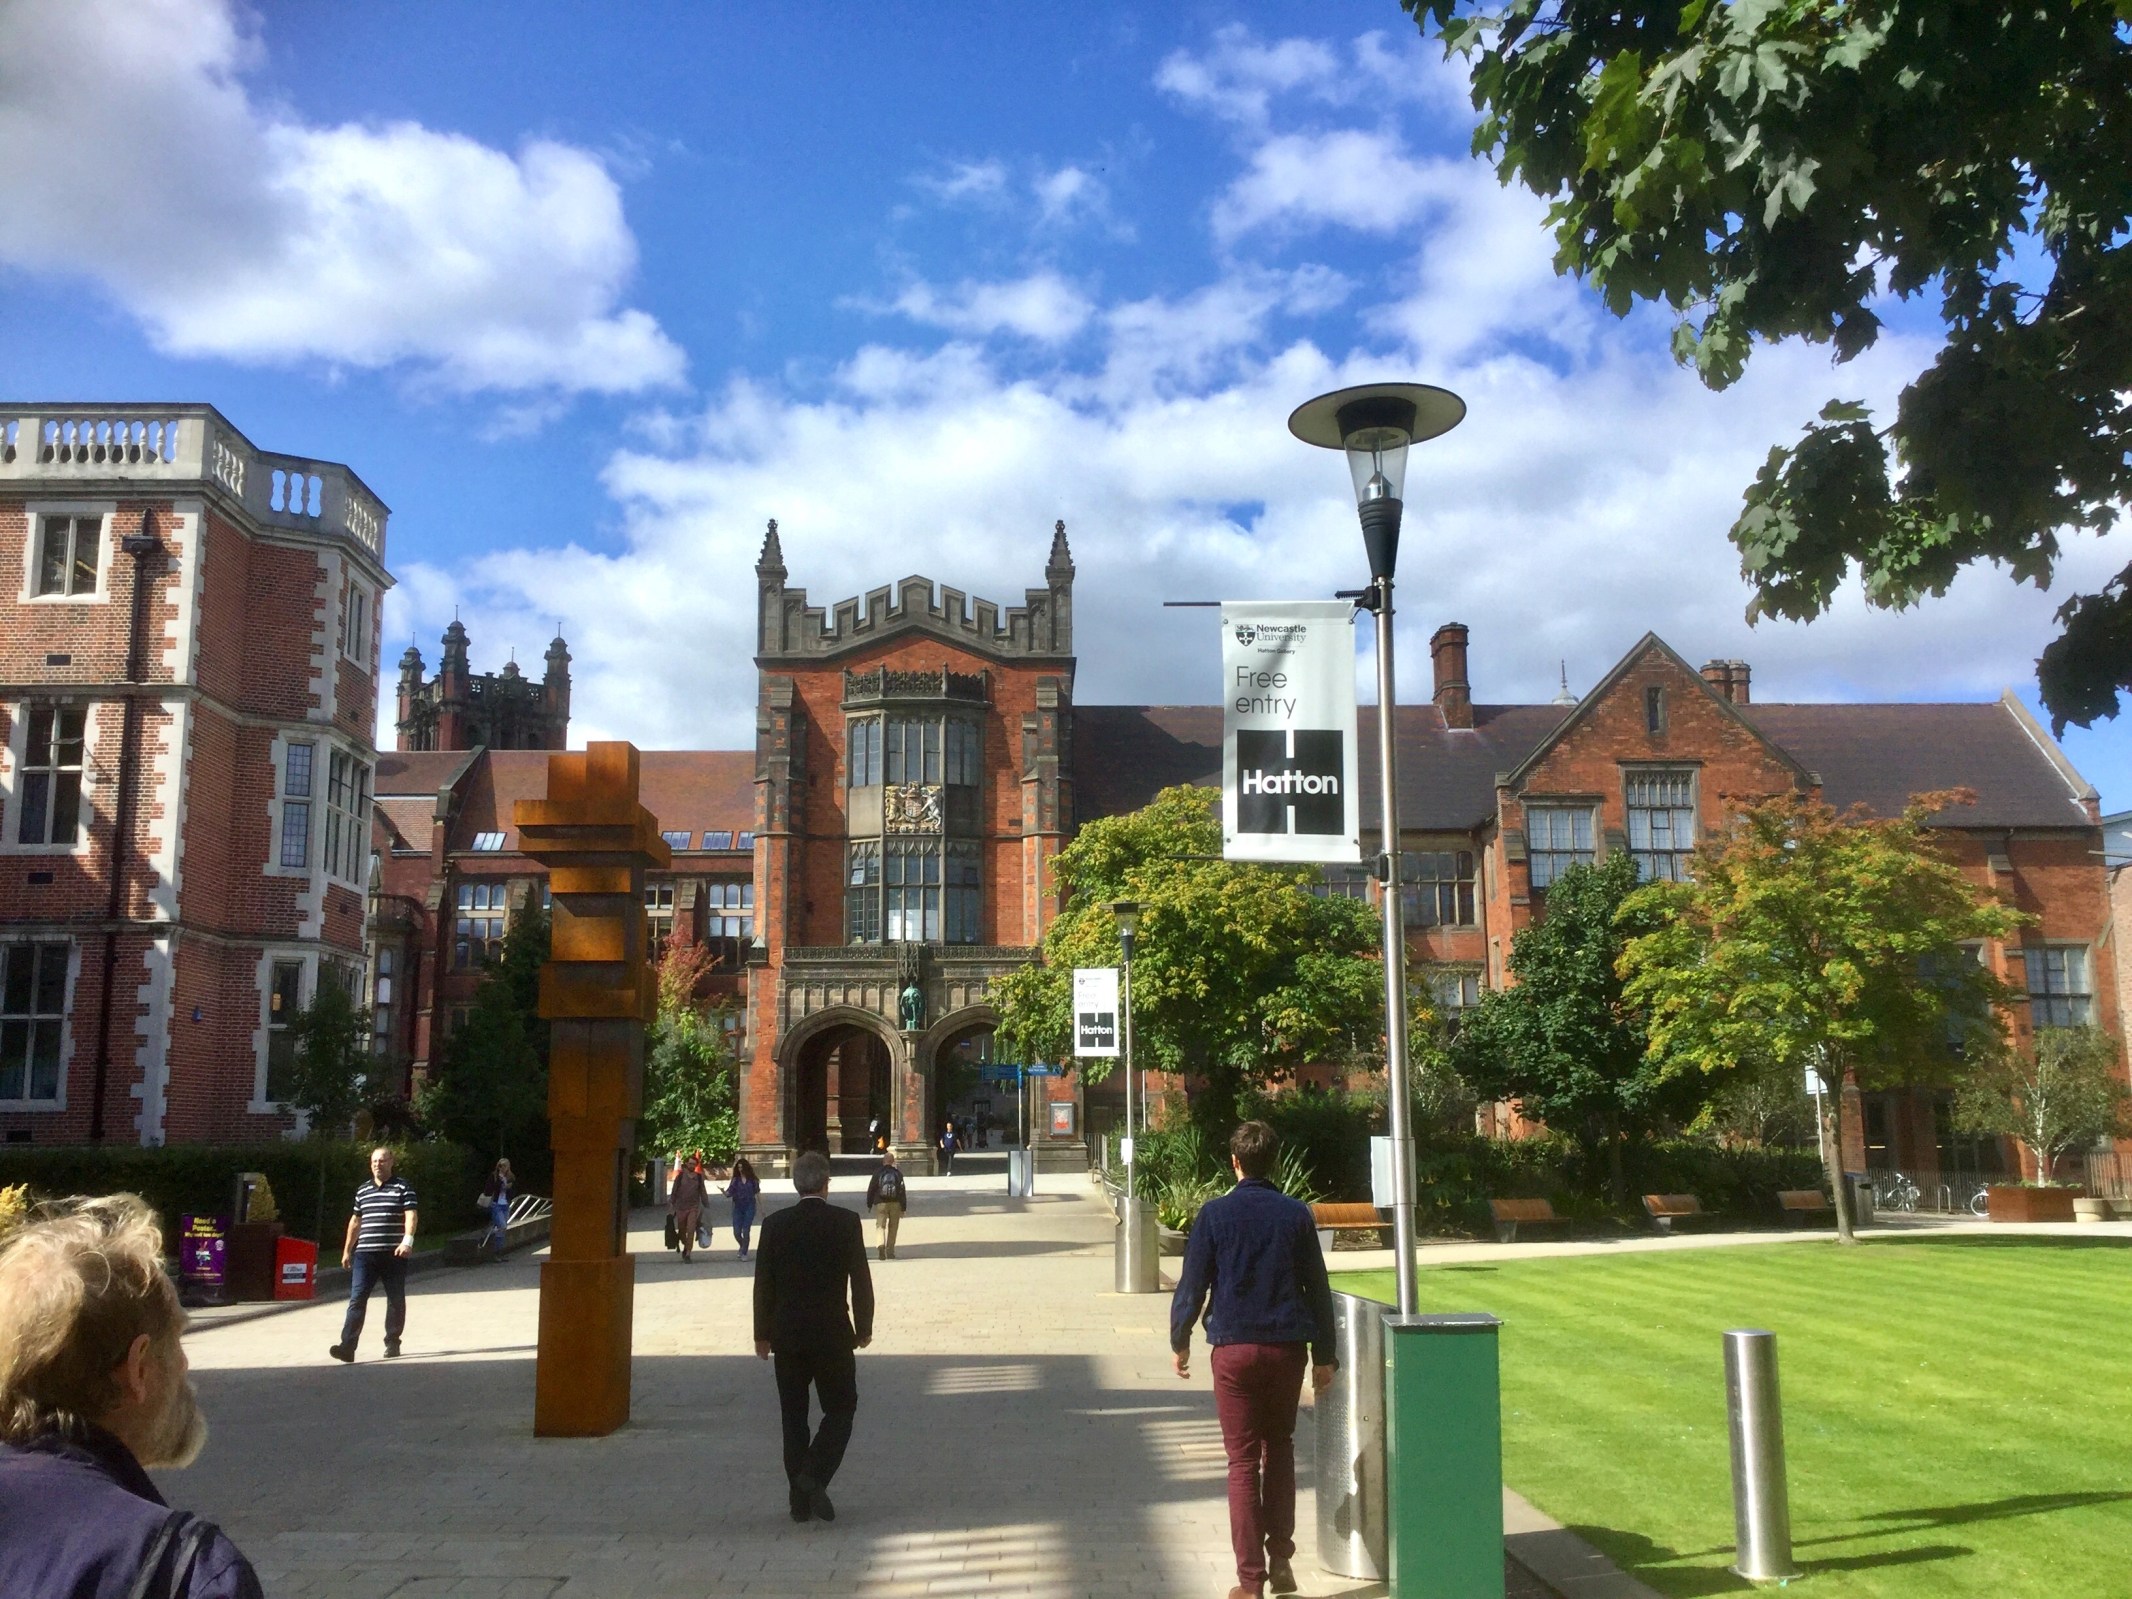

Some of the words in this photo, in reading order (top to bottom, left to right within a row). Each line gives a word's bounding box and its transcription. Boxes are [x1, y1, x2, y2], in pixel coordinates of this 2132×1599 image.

[1257, 624, 1306, 633] Newcastle
[1257, 632, 1306, 643] University
[1236, 666, 1287, 689] Free
[1236, 694, 1297, 719] entry
[1243, 769, 1338, 795] Hatton
[1081, 1025, 1113, 1035] Hatton
